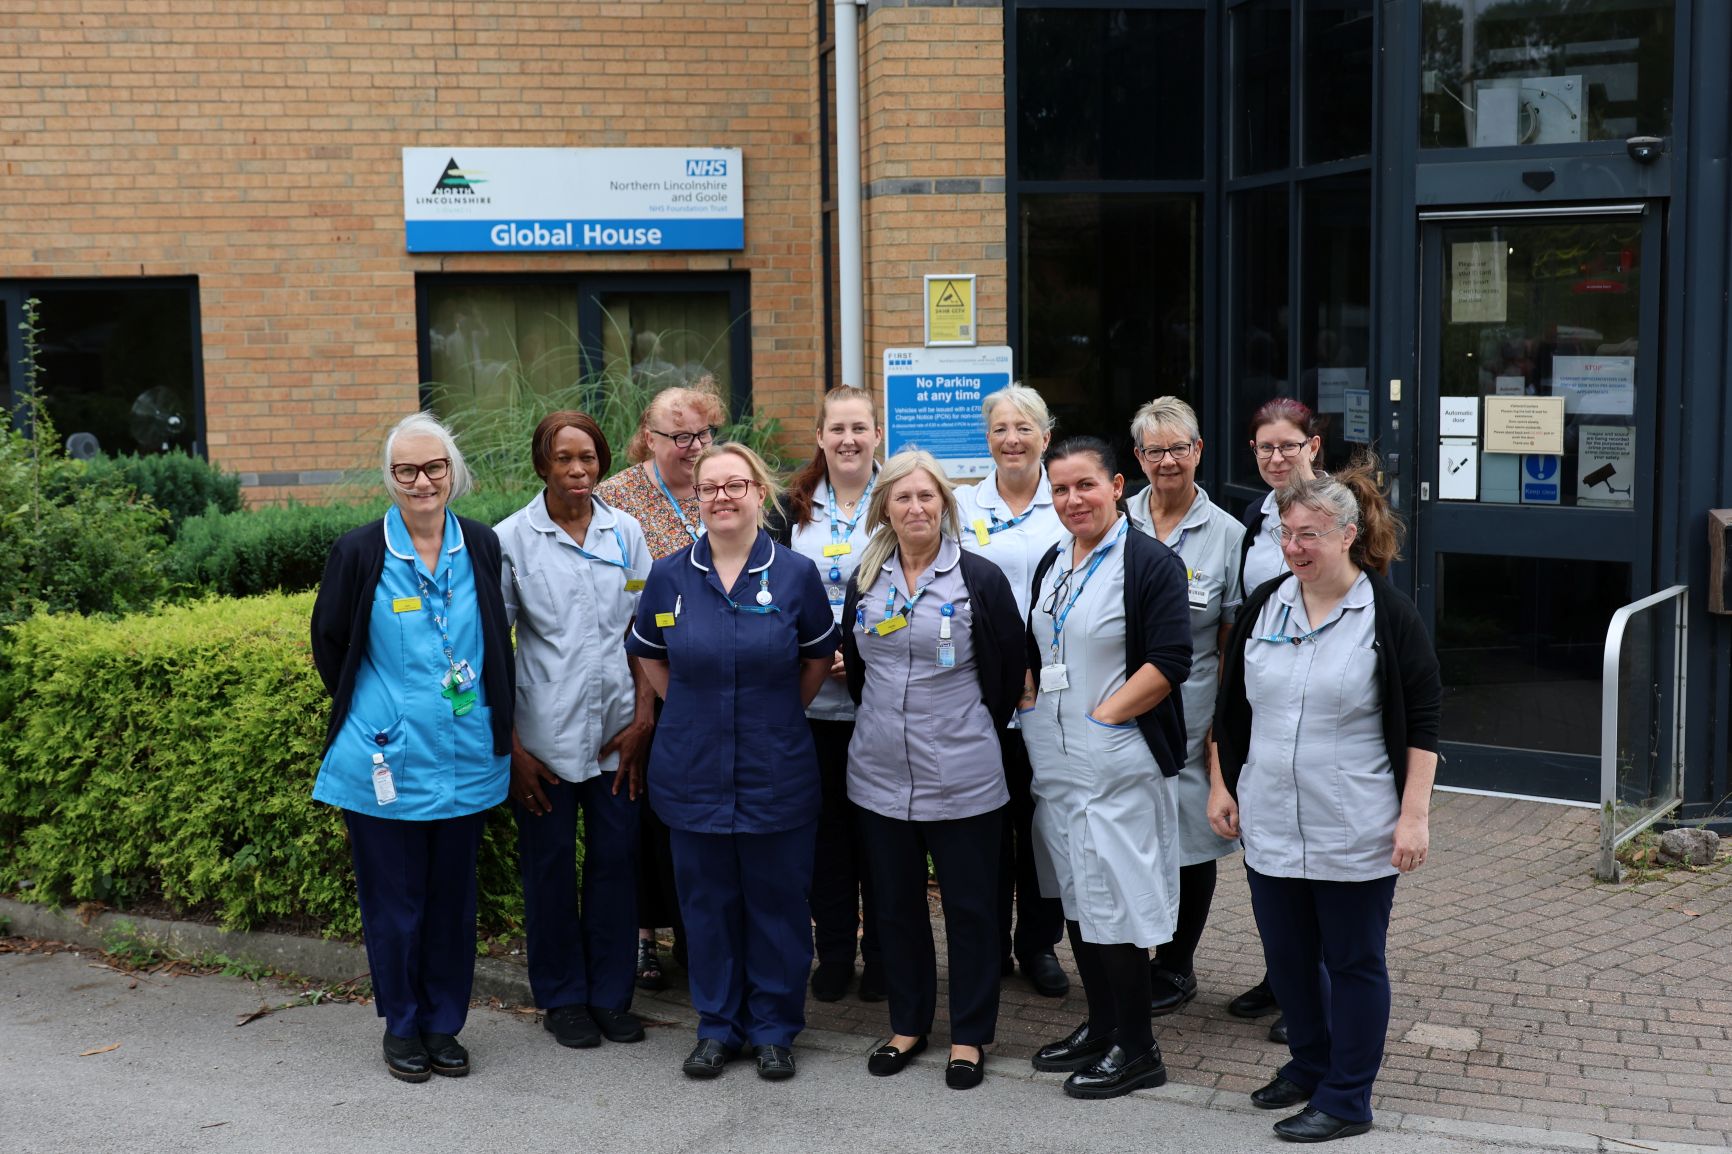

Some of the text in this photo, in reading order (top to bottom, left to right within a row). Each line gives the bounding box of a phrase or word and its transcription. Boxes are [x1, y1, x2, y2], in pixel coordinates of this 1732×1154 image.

[687, 160, 727, 176] NHS
[610, 180, 728, 190] Northern Lincolnshire
[435, 187, 472, 195] NORTH
[672, 192, 728, 202] and Goole
[491, 223, 662, 246] Global House
[916, 376, 981, 389] No Parking
[917, 390, 981, 403] at any time
[1525, 487, 1540, 496] Keep
